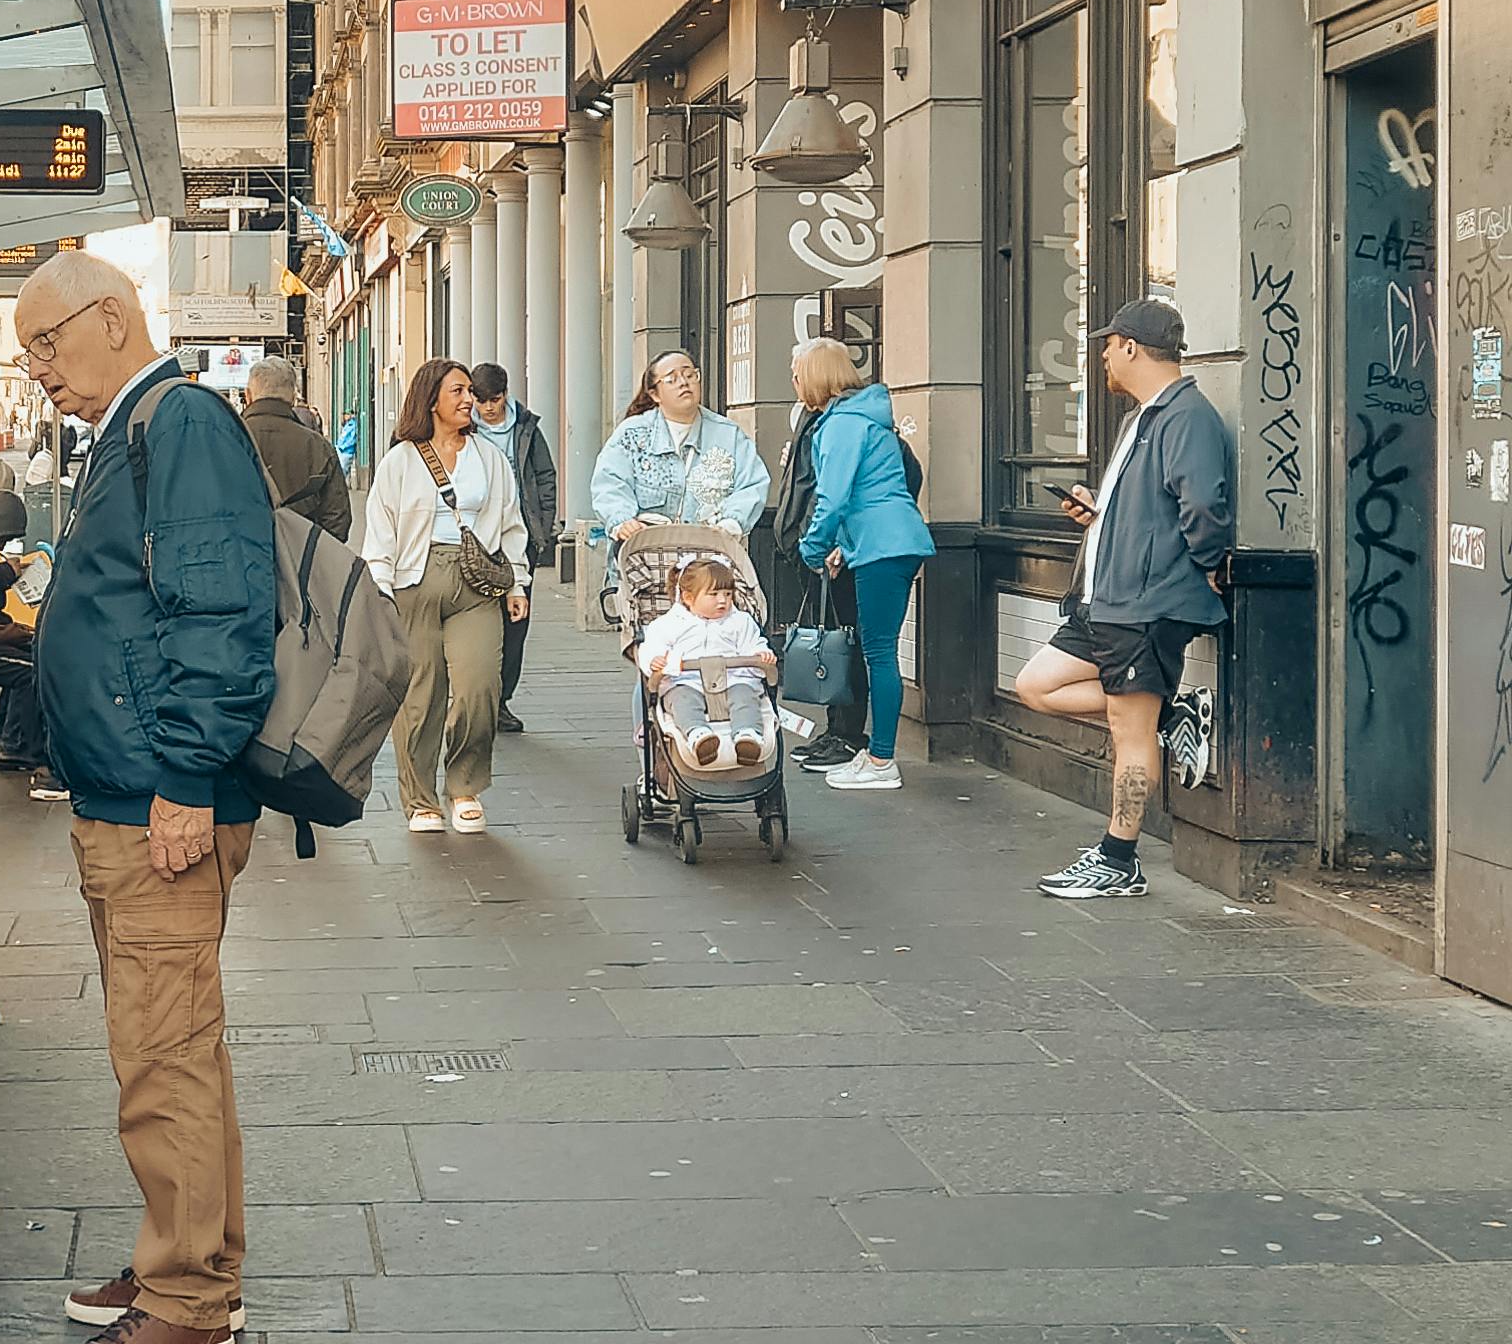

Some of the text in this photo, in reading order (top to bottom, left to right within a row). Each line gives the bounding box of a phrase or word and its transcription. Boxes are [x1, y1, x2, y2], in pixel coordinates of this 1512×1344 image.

[431, 30, 528, 57] TO LET
[399, 56, 562, 80] CLASS 3 CONSENT
[422, 78, 537, 99] APPLIED FOR
[418, 101, 543, 122] 0141 212 0059
[62, 125, 86, 136] Due
[420, 117, 542, 133] WWW.GMBROWN.CO.UK
[55, 138, 86, 149] 2min
[55, 151, 86, 162] 4min
[48, 164, 86, 176] 11:27
[422, 190, 460, 201] UNION
[421, 201, 460, 211] COURT
